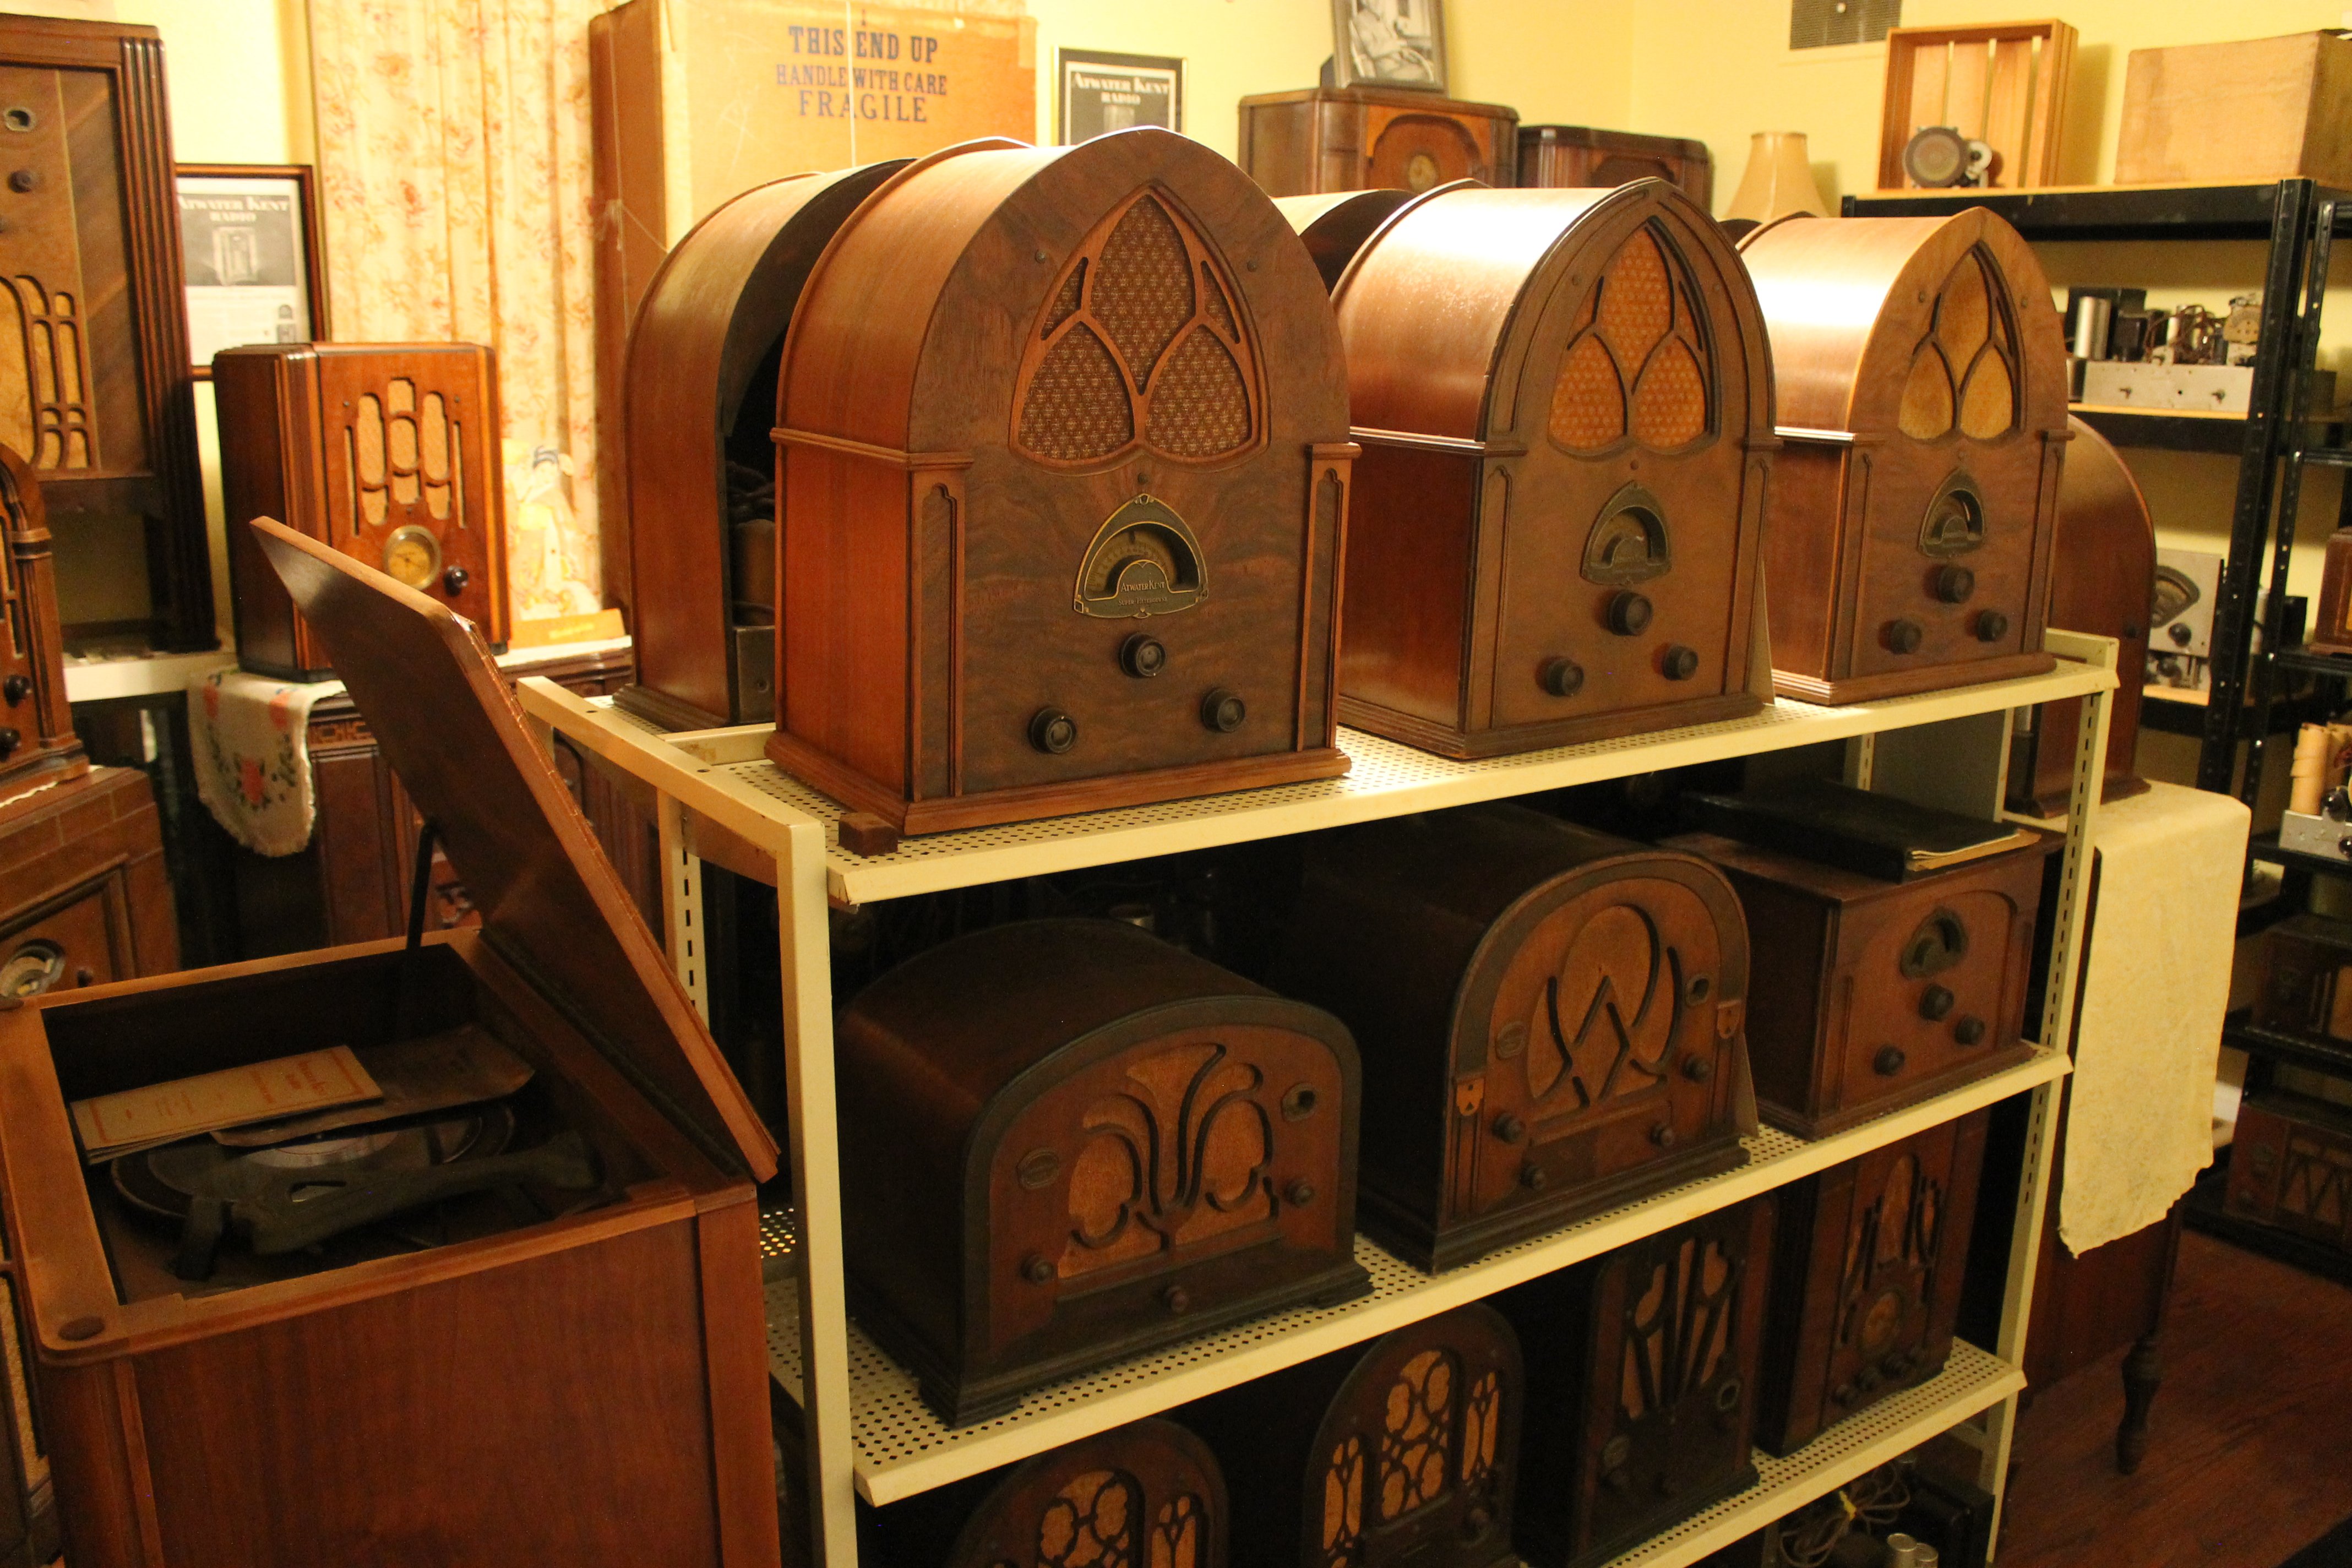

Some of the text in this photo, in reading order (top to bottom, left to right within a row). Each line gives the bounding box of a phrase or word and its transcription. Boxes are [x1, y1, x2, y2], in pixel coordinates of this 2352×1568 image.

[788, 25, 938, 63] THIS END UP
[777, 64, 947, 95] HANDLE WITH CARE
[798, 90, 927, 123] FRAGILE
